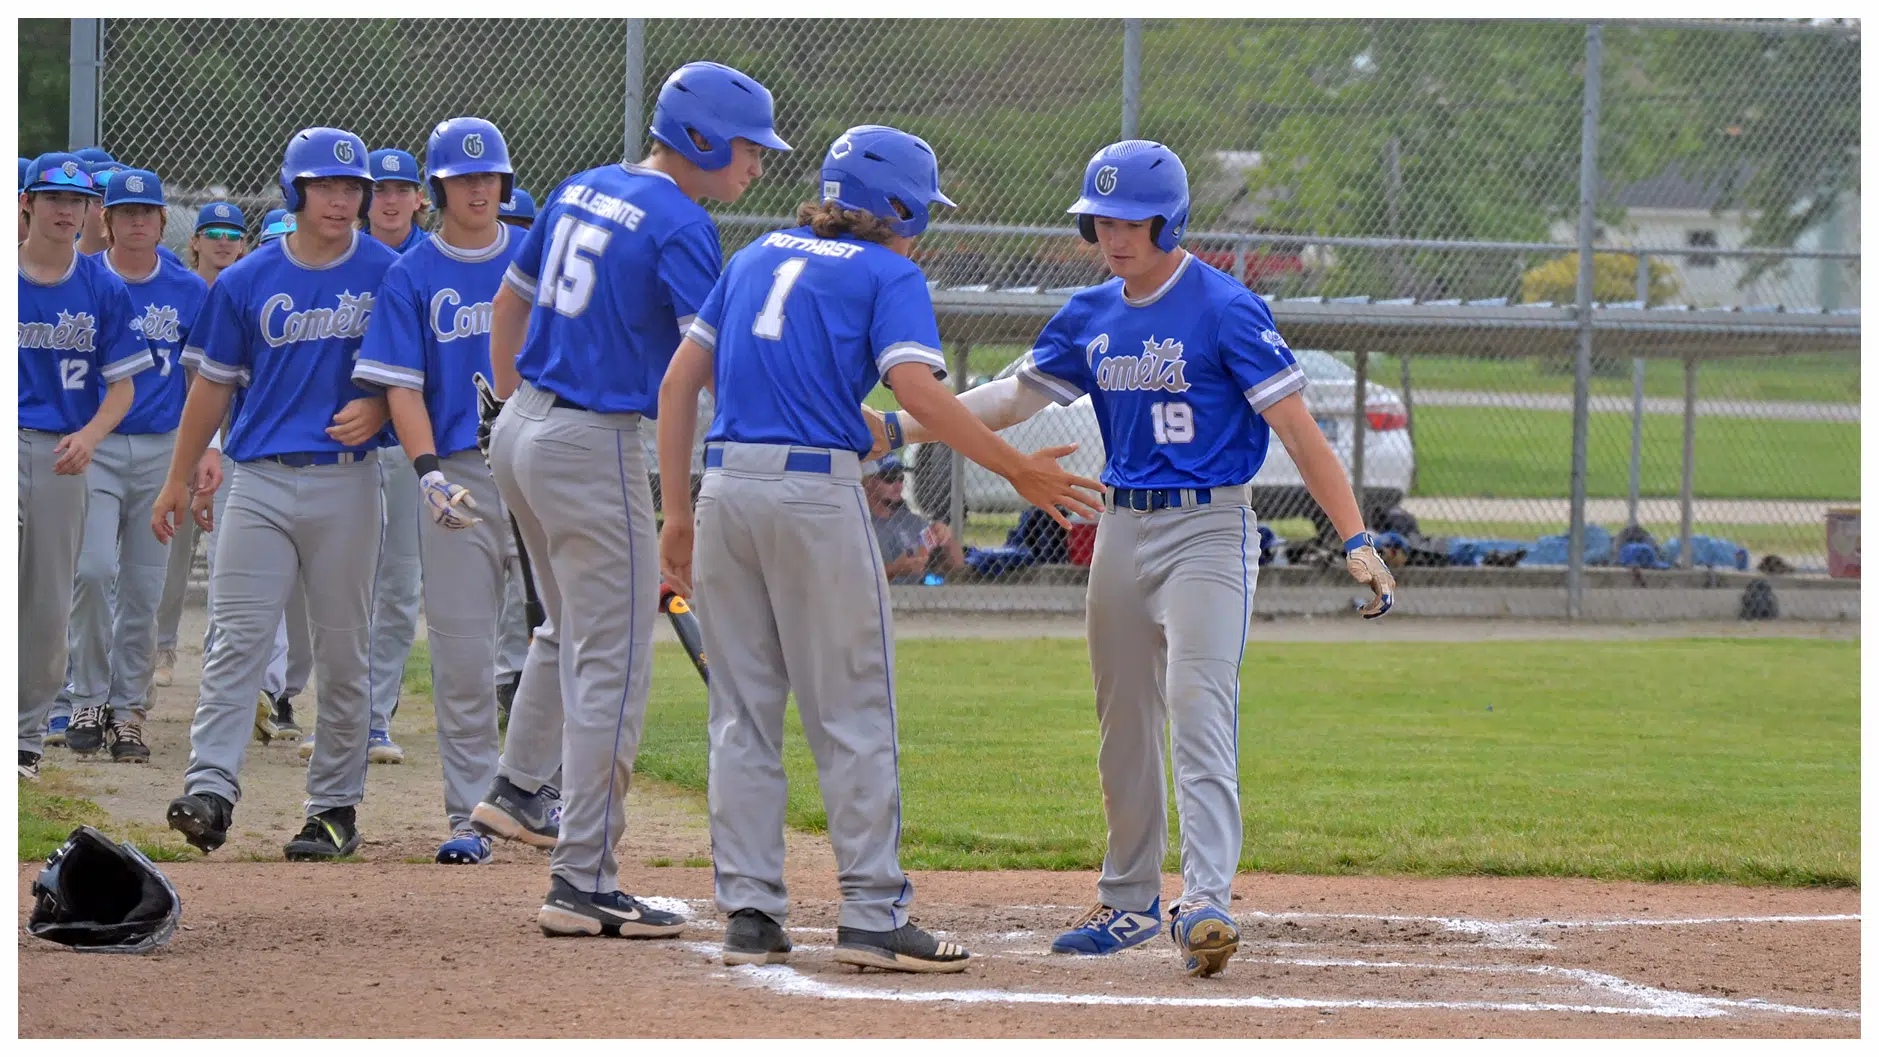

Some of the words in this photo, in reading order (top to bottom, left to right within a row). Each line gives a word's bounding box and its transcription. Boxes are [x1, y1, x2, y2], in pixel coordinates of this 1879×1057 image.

[537, 212, 613, 319] 15
[760, 232, 865, 259] POTTHAST
[141, 302, 181, 343] ets
[260, 288, 377, 348] Comet
[430, 287, 494, 343] Com
[751, 256, 809, 341] 1
[18, 308, 97, 353] mets
[60, 357, 90, 390] 12
[1085, 333, 1192, 394] Comets
[1150, 401, 1196, 445] 19
